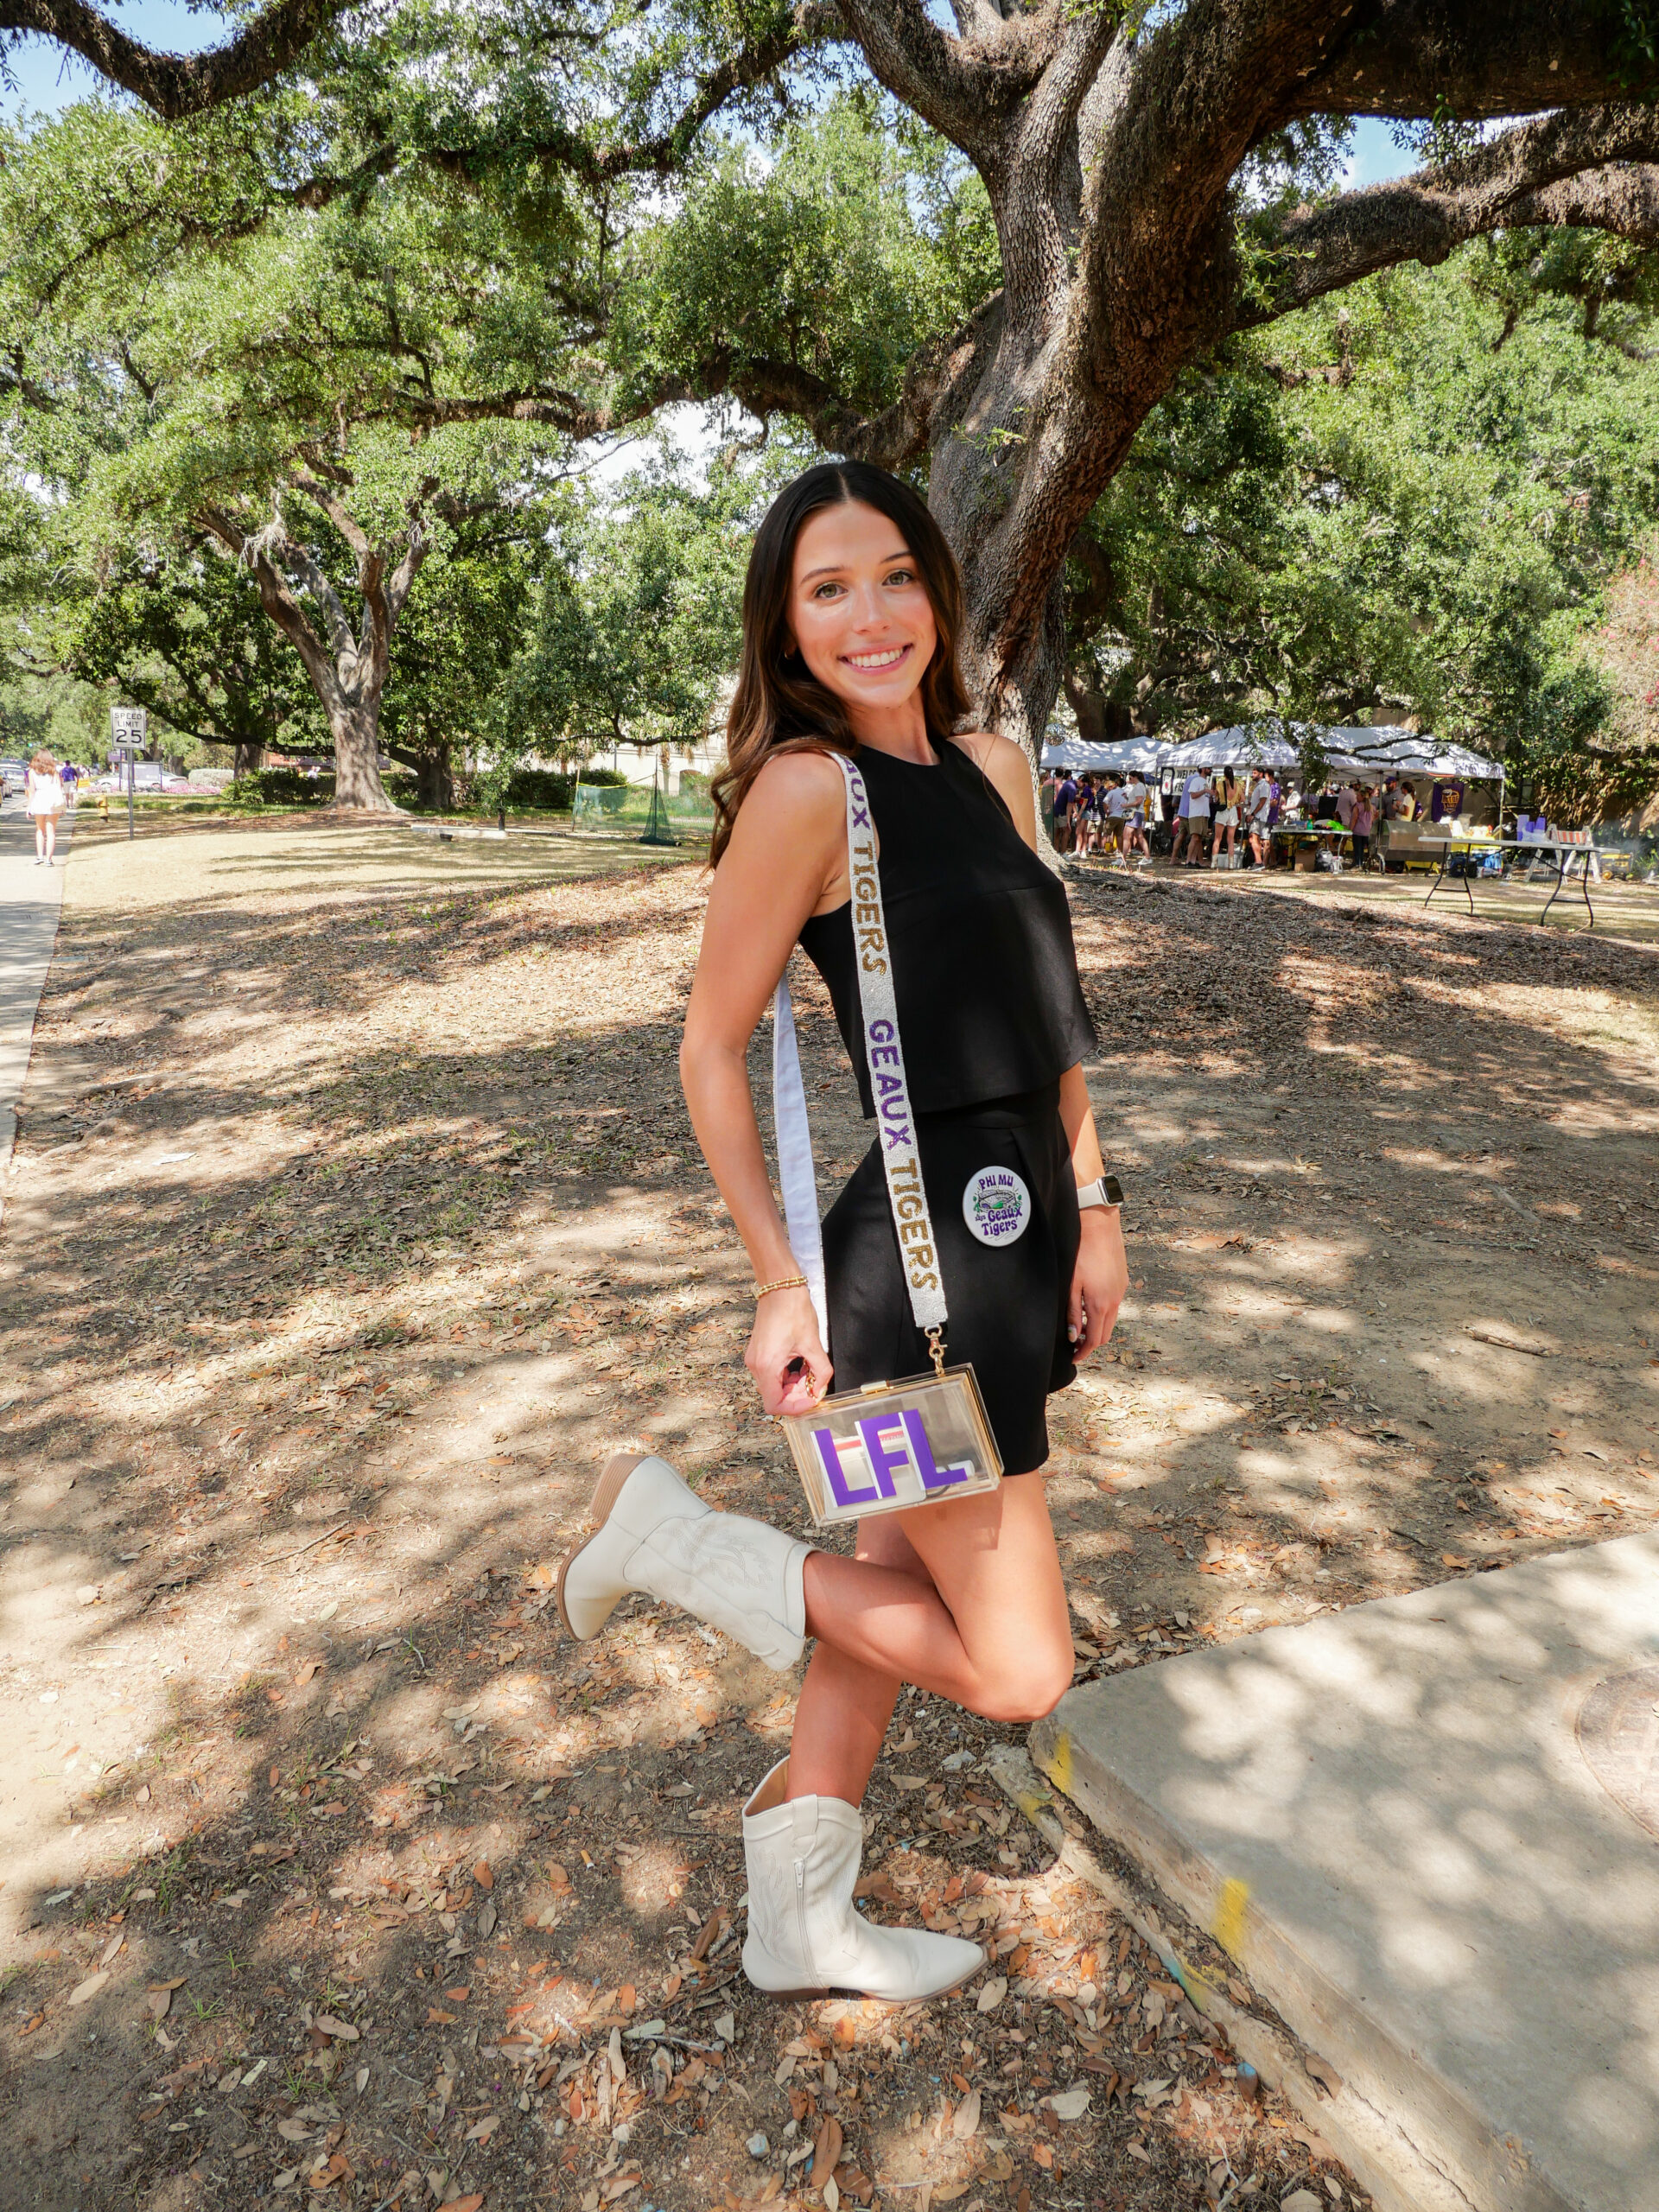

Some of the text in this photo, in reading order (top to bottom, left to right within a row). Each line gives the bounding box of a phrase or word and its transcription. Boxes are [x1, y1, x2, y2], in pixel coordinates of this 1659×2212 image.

[116, 729, 142, 743] 25
[853, 841, 887, 976] TIGERS
[868, 1019, 939, 1292] GEAUX TIGERS
[978, 1174, 1014, 1190] PHI MU
[988, 1206, 1023, 1223] Geaux
[982, 1219, 1018, 1236] Tigers
[810, 1408, 969, 1508] LFL
